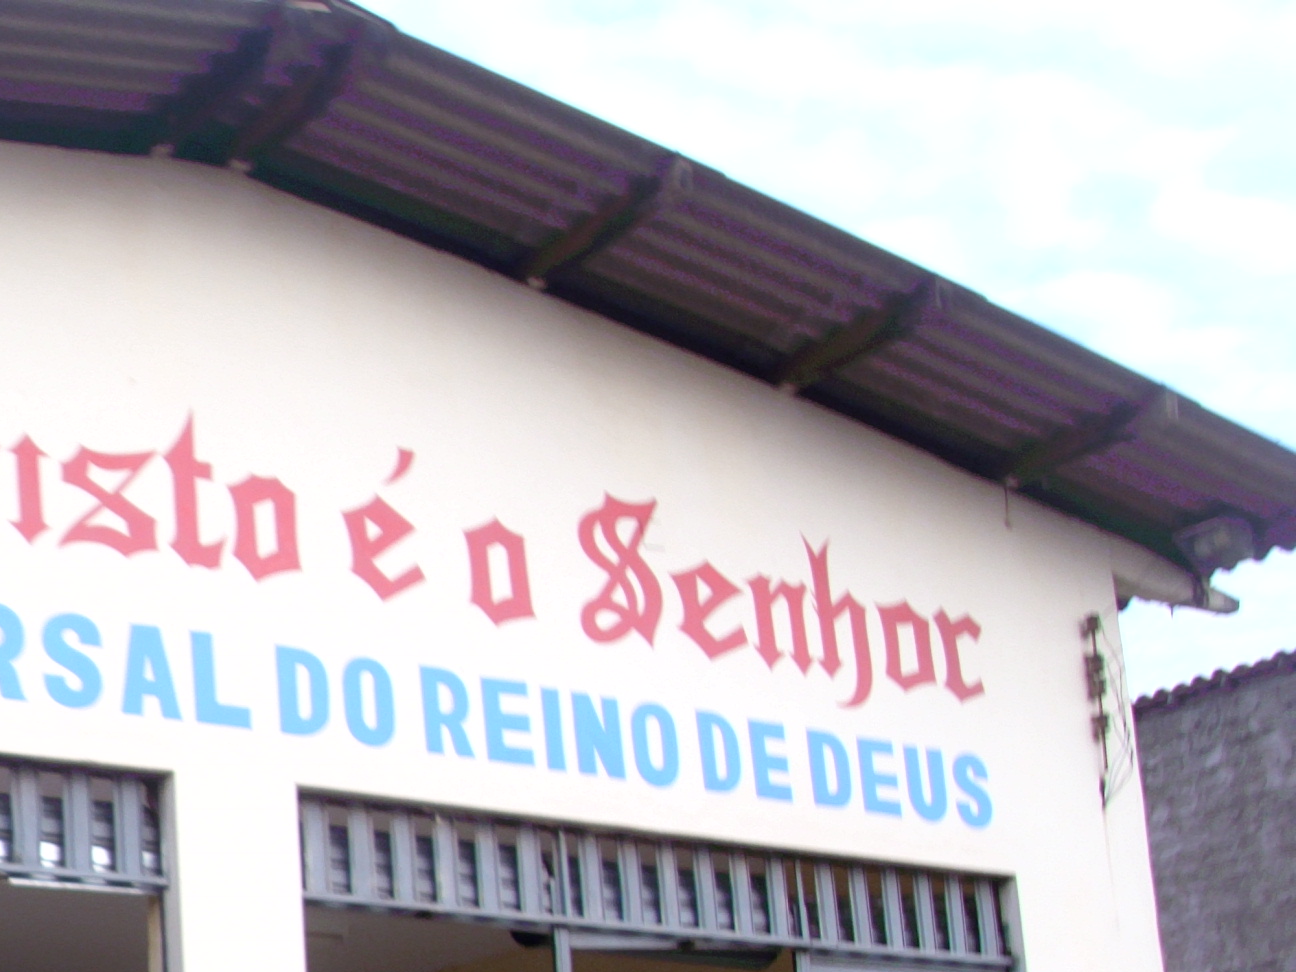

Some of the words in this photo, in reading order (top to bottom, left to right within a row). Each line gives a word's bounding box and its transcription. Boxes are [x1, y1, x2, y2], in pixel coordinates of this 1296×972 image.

[343, 448, 424, 602] é
[464, 518, 534, 626] o
[578, 492, 985, 708] Senhor
[275, 645, 396, 747] DO
[419, 665, 680, 788] REINO
[695, 710, 794, 803] DE
[806, 729, 994, 829] DEUS
